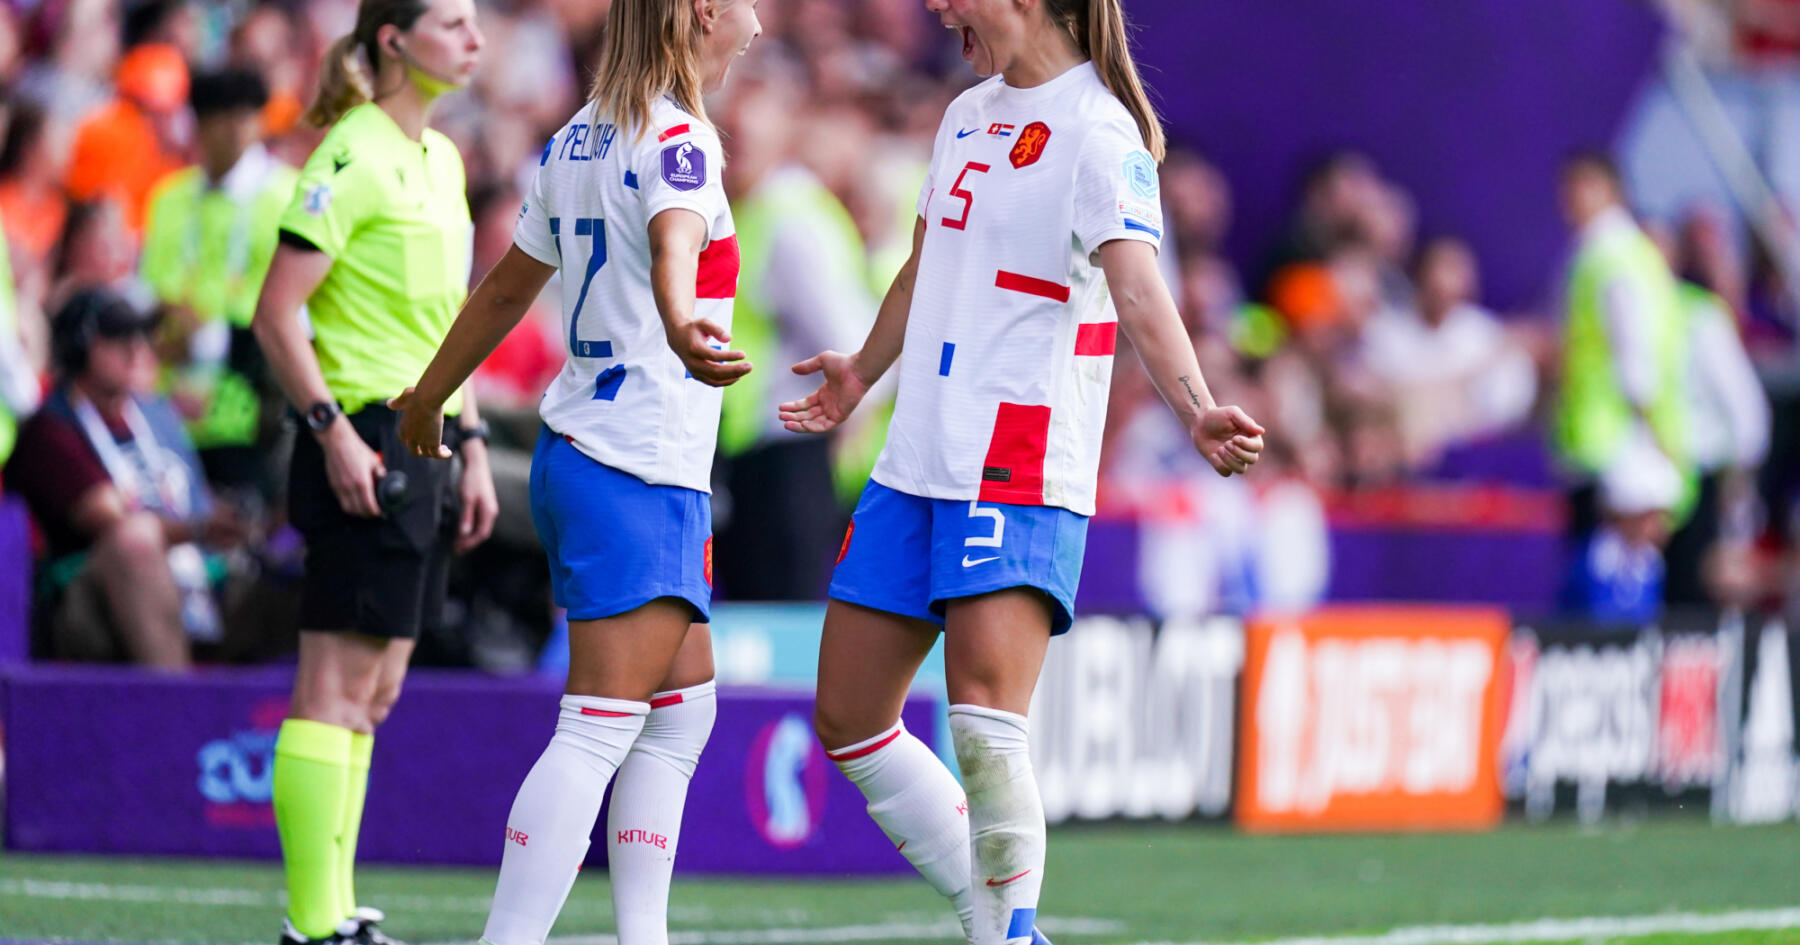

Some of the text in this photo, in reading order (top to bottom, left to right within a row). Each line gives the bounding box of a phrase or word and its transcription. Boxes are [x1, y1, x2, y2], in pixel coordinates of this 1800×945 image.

[941, 161, 991, 231] 5
[964, 499, 1006, 548] 5
[506, 827, 529, 847] NVB
